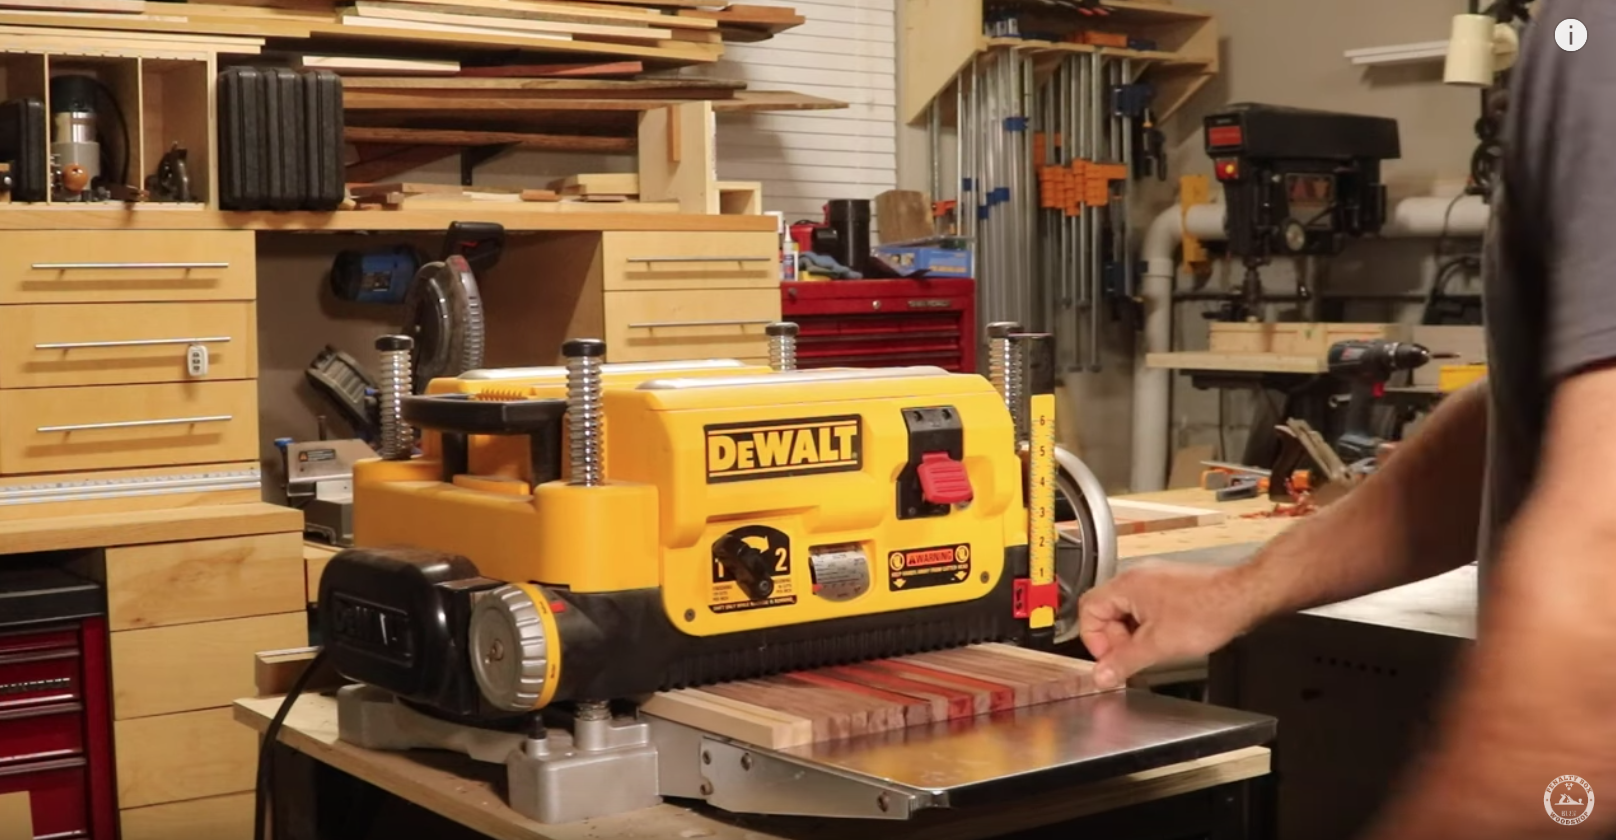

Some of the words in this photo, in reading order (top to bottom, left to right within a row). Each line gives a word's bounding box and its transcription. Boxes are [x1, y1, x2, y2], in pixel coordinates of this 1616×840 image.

[1040, 414, 1046, 426] 6
[1040, 445, 1046, 457] 5
[1040, 476, 1046, 487] 4
[1040, 506, 1046, 518] 3
[1039, 536, 1045, 547] 2
[775, 547, 787, 571] 2
[915, 551, 952, 563] WARNING
